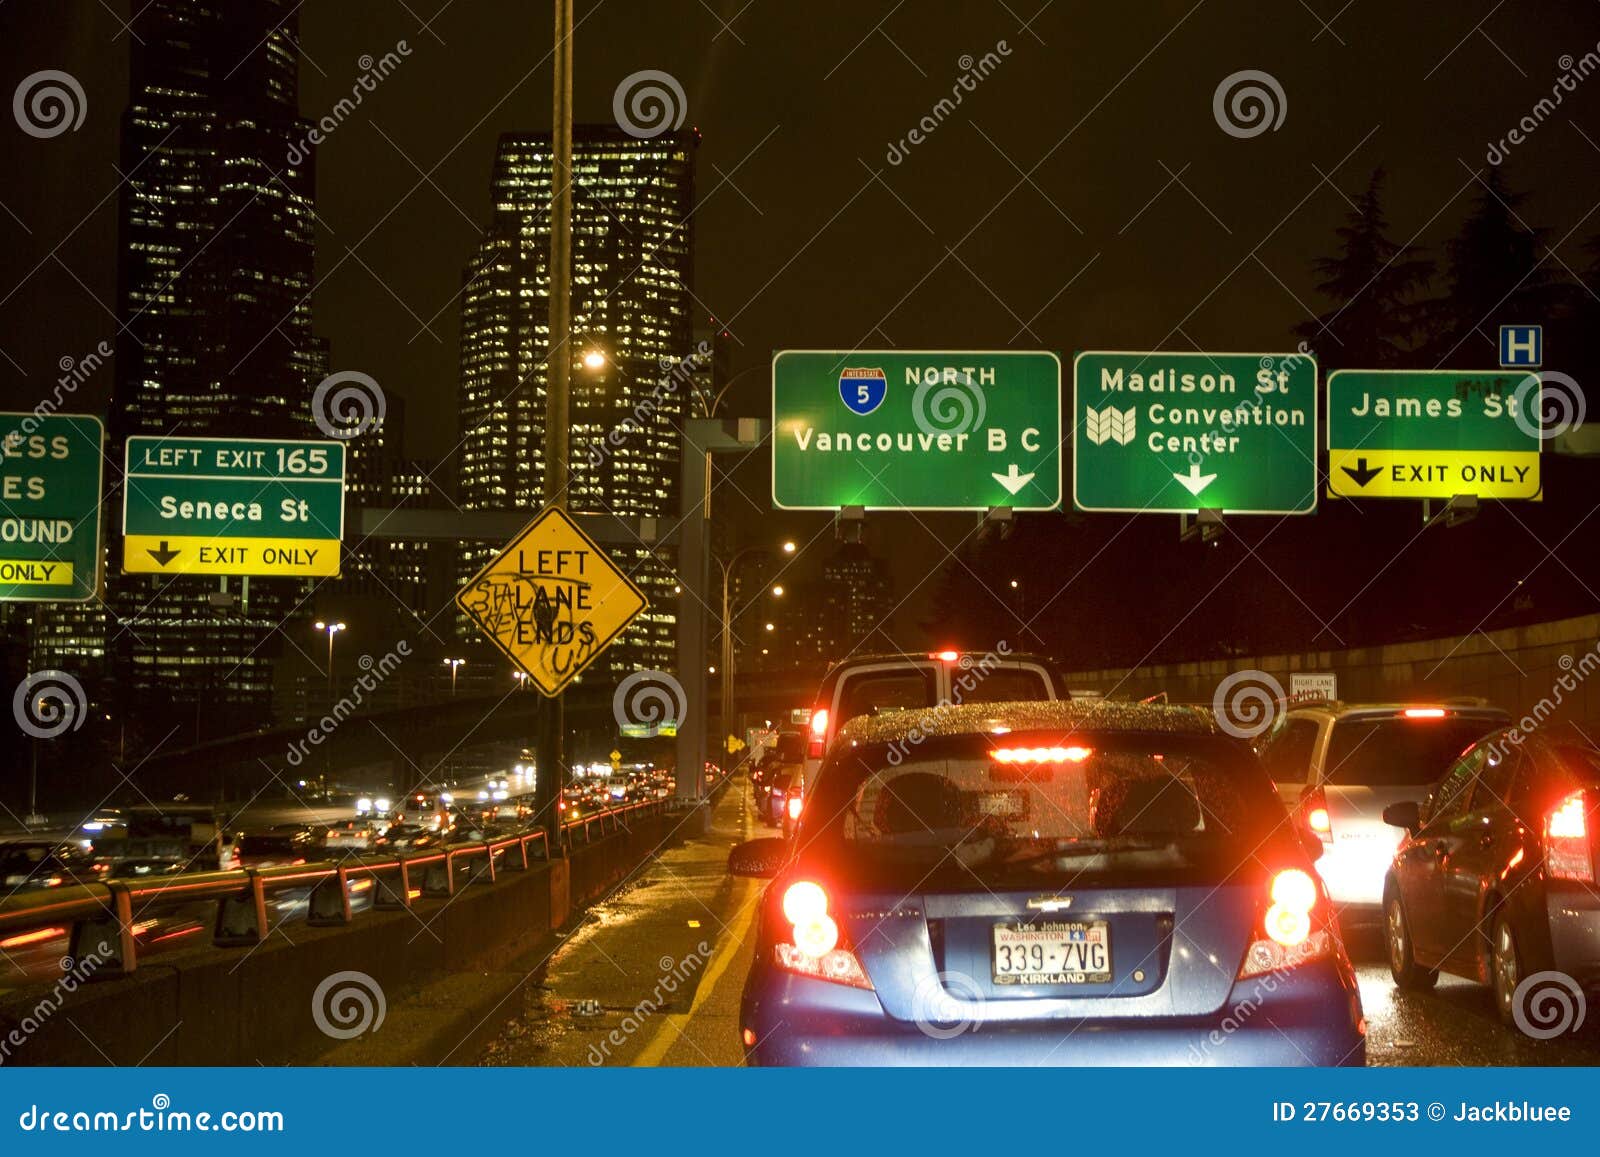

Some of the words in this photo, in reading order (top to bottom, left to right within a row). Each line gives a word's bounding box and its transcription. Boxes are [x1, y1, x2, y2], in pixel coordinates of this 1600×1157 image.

[1507, 329, 1535, 363] H
[904, 367, 996, 386] NORTH
[1101, 368, 1236, 393] Madison
[1255, 369, 1289, 394] St
[857, 385, 870, 404] 5
[1351, 392, 1463, 418] James
[1483, 392, 1518, 418] St
[1148, 404, 1305, 426] Convention
[793, 427, 969, 452] Vancouver
[987, 427, 1007, 452] B
[1021, 427, 1041, 452] C
[1148, 431, 1240, 453] Center
[145, 448, 202, 468] LEFT
[216, 450, 266, 469] EXIT
[276, 448, 328, 474] 165
[1391, 465, 1449, 482] EXIT
[1461, 465, 1531, 484] ONLY
[160, 496, 262, 521] Seneca
[280, 498, 309, 522] St
[199, 547, 249, 564] EXIT
[262, 548, 319, 566] ONLY
[519, 550, 590, 575] LEFT
[0, 563, 58, 582] ONLY
[515, 585, 593, 610] LANE
[516, 621, 595, 645] ENDS
[1000, 931, 1065, 942] WASHINGTON
[1041, 921, 1084, 932] Johnson
[1019, 973, 1086, 984] KIRKLAND
